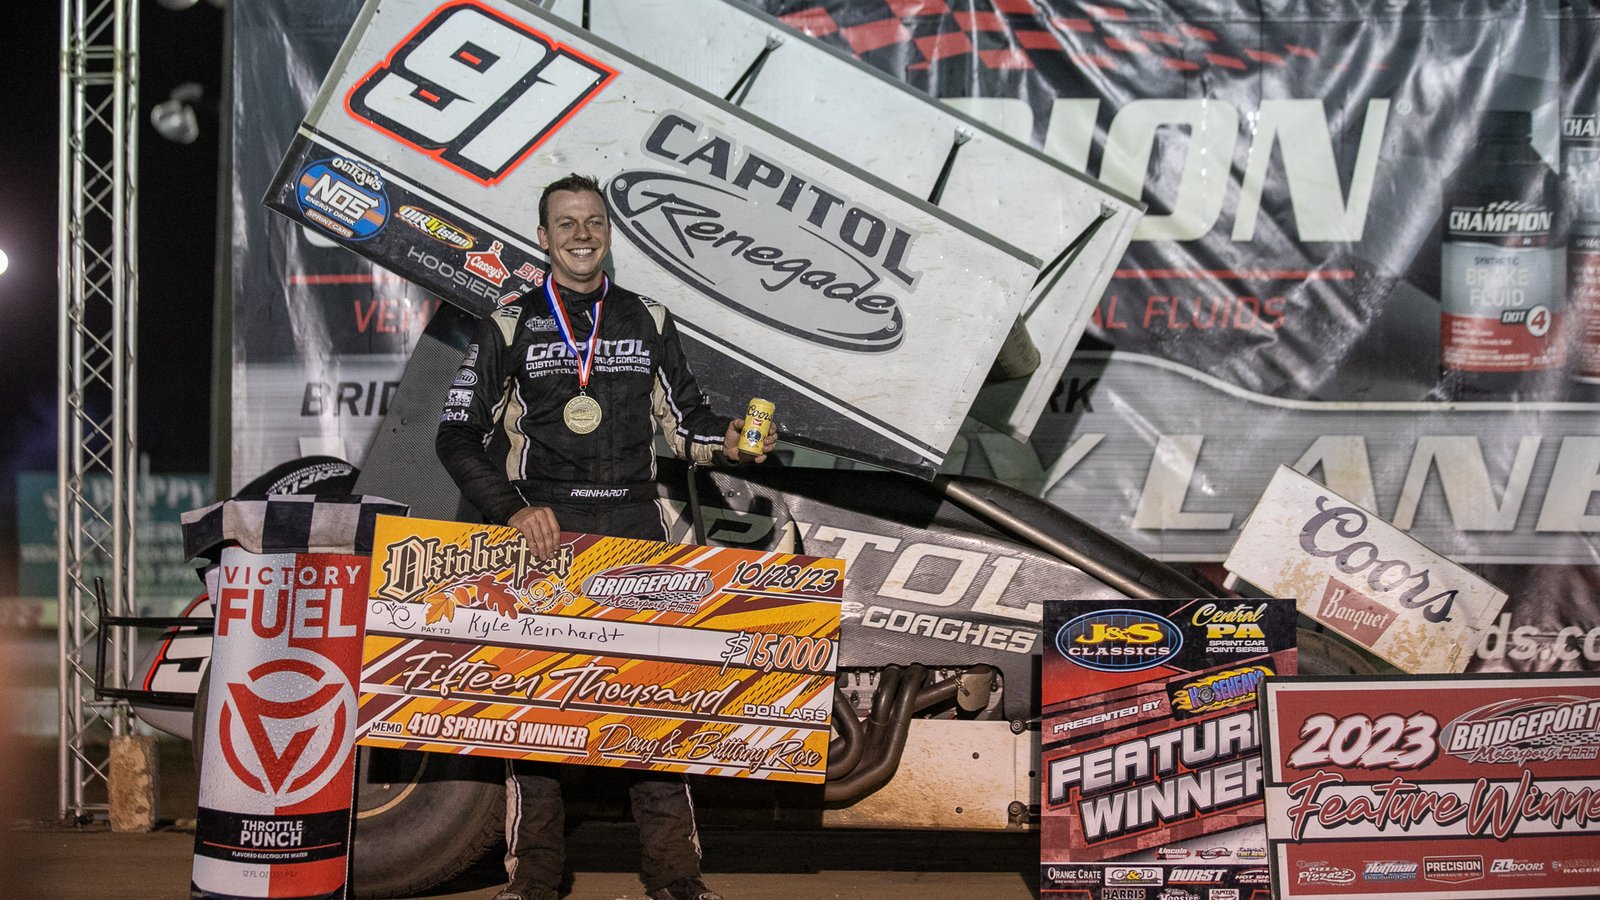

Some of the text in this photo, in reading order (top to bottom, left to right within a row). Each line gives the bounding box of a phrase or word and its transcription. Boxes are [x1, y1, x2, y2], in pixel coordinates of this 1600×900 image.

[353, 3, 616, 183] 91
[331, 157, 383, 191] OUTLAWS
[309, 172, 379, 221] NOS
[644, 113, 916, 287] CAPITOL
[304, 195, 356, 226] ENERGY DRINK
[1449, 211, 1552, 232] CHAMPION
[306, 211, 352, 237] SPRINT CARS
[632, 190, 897, 314] Renegade
[1474, 255, 1520, 266] SYNTHETIC
[406, 245, 501, 304] HOOSIER
[469, 255, 505, 279] Casey's
[1465, 268, 1530, 287] BRAKE
[1470, 288, 1525, 306] FLUID
[1143, 294, 1286, 331] FLUIDS
[1502, 309, 1547, 331] DOT 4
[525, 359, 562, 371] CUSTOM
[570, 488, 629, 498] REINHARDT
[1299, 495, 1460, 624] Coors
[223, 564, 363, 585] VICTORY
[588, 571, 709, 598] BRIDGEPORT
[731, 560, 840, 593] 10/28/23
[217, 588, 358, 639] FUEL
[1192, 602, 1268, 627] Central
[1321, 587, 1391, 638] Banquet
[420, 626, 451, 635] PAY TO
[467, 612, 625, 643] Kyle Reinhardt
[860, 605, 1038, 654] COACHES
[1076, 623, 1164, 644] J&S
[1206, 623, 1266, 639] PA
[721, 632, 831, 675] $15,000
[1068, 646, 1171, 657] CLASSICS
[1232, 646, 1269, 654] SERIES
[402, 650, 742, 716] Fifteen Thousand
[743, 704, 827, 721] DOLLARS
[1053, 699, 1163, 734] PRESENTED BY
[371, 712, 589, 749] MEMO 410 SPRINTS WINNER
[1449, 700, 1600, 751] BRIDGEPORT
[598, 723, 822, 773] Doug & Brittany Rose
[1286, 711, 1440, 771] 2023
[1051, 710, 1260, 800] FEATUR
[1468, 744, 1558, 768] Motorsports
[1287, 769, 1468, 842] Feature
[241, 820, 303, 832] THROTTLE
[240, 831, 302, 847] PUNCH
[231, 850, 258, 859] FLAVORED
[257, 852, 290, 860] ELECTROLYTE
[1426, 860, 1481, 872] PRECISION
[1510, 862, 1545, 872] DOORS
[1047, 866, 1102, 880] ORANGE CRATE
[1111, 868, 1158, 880] C&D
[1168, 869, 1228, 882] DURST
[1102, 888, 1145, 899] HARRIS
